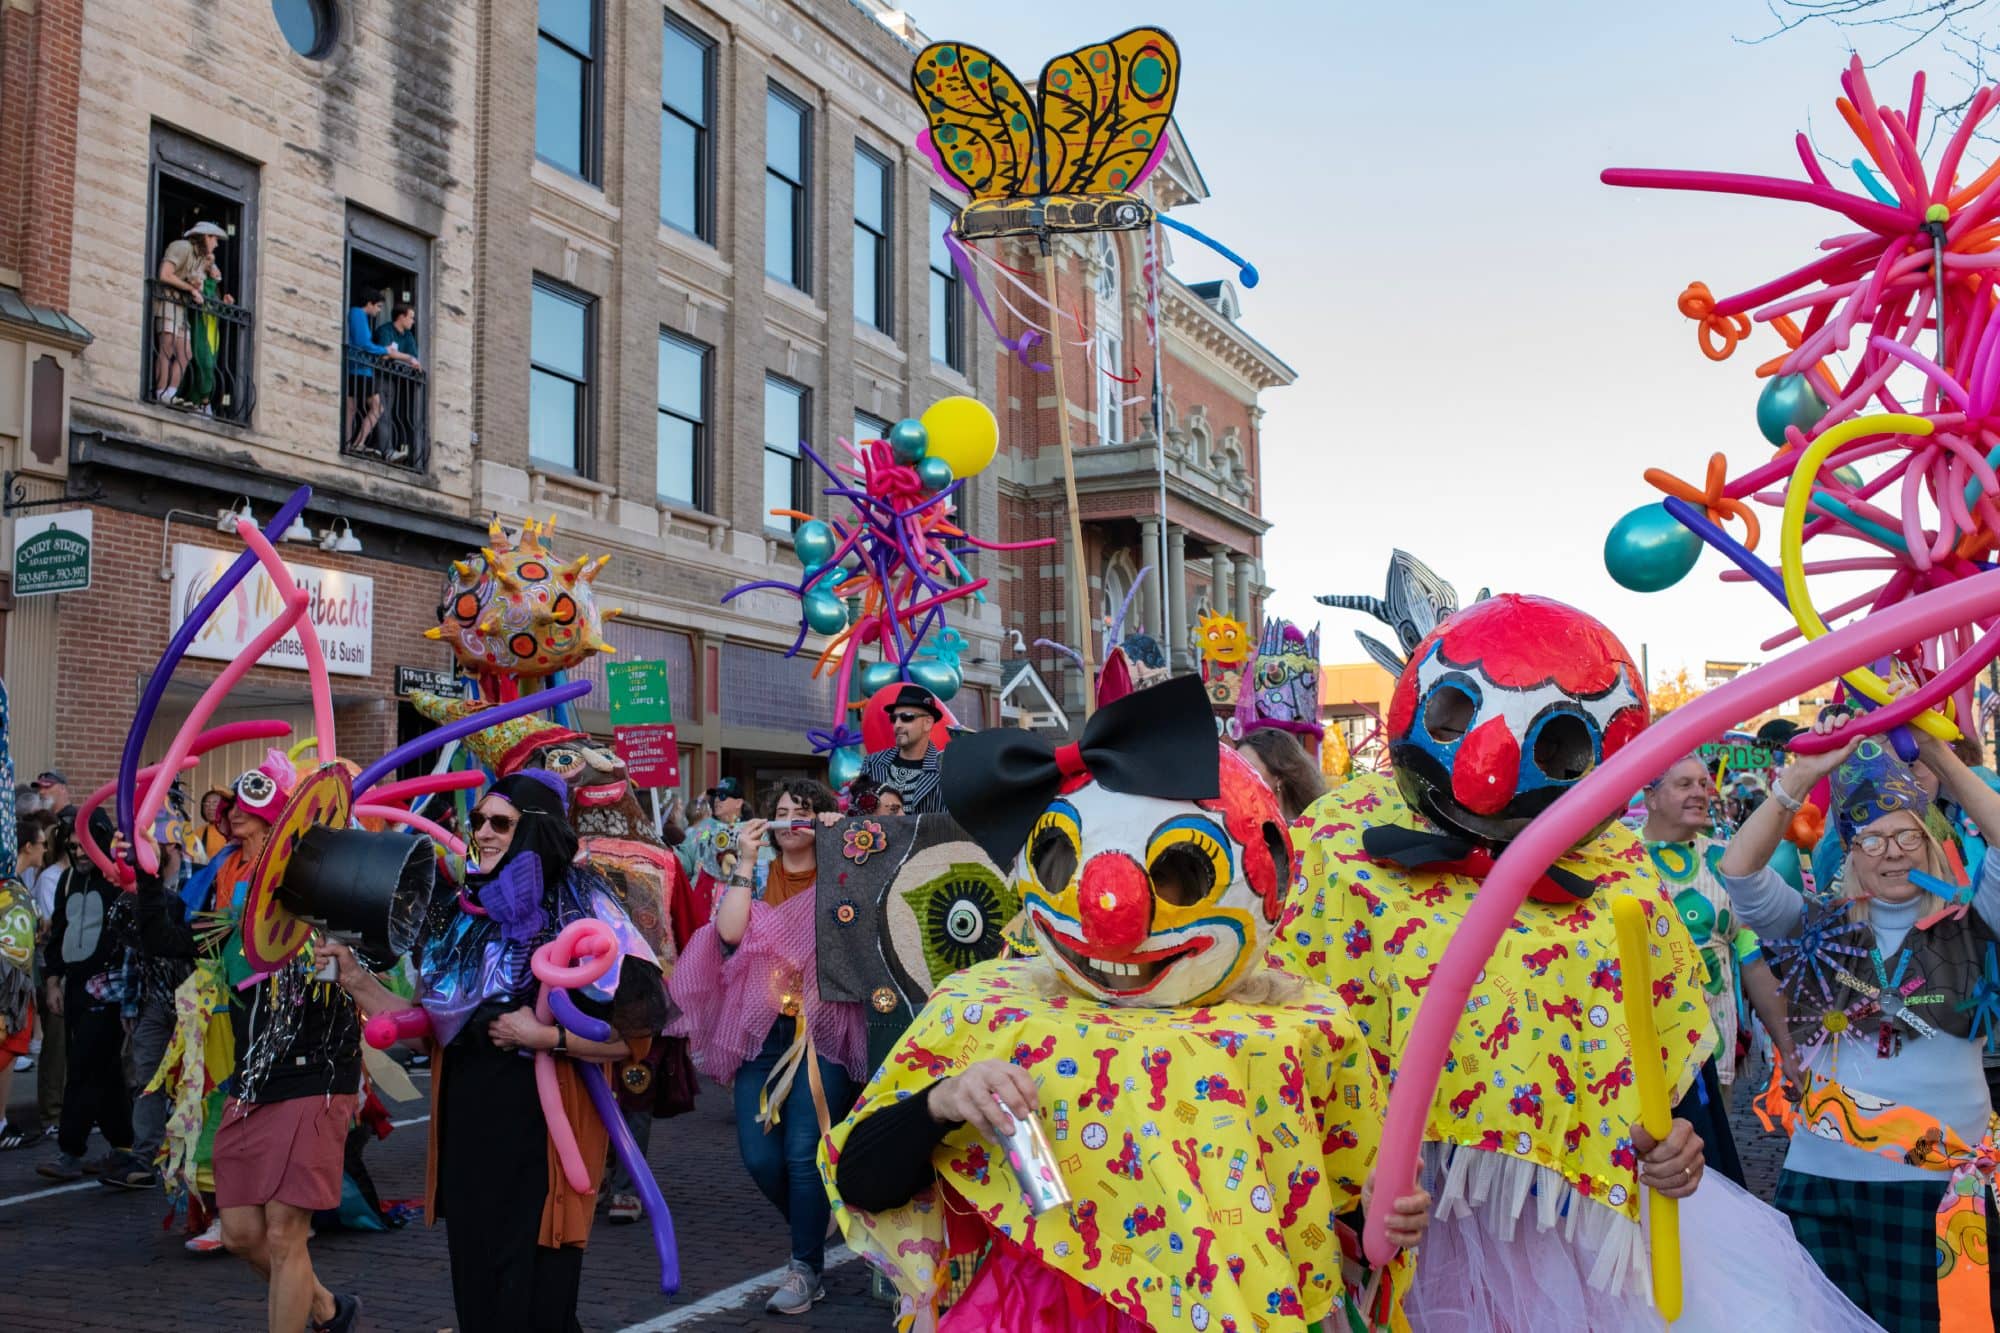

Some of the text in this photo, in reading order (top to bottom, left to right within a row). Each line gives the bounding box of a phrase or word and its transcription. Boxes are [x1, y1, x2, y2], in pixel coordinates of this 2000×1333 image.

[19, 539, 86, 563] COURT STREET
[29, 555, 76, 566] APARTMENTS
[270, 639, 305, 656] panese
[330, 640, 336, 660] &
[339, 641, 365, 663] Sushi
[1669, 940, 1687, 974] ELMO
[1493, 975, 1518, 1005] ELMO
[954, 1033, 979, 1070] ELMO
[1058, 1152, 1082, 1175] EL
[1210, 1207, 1242, 1225] ELM
